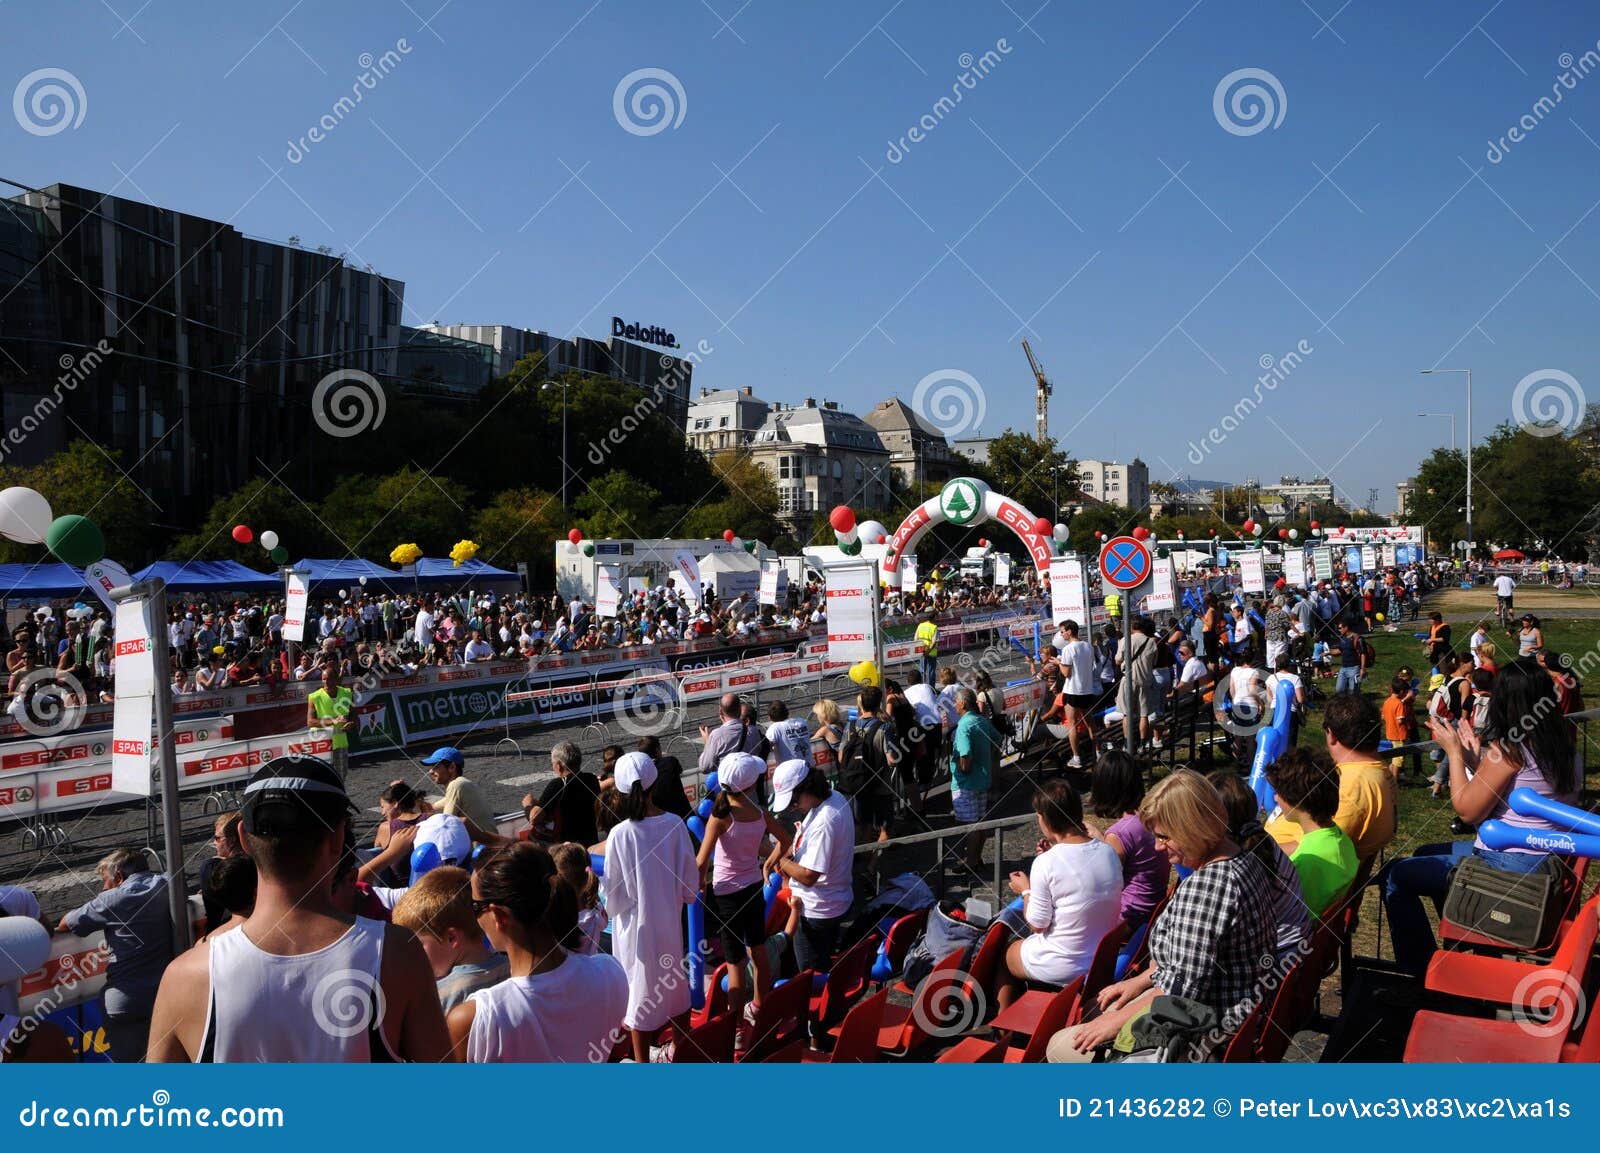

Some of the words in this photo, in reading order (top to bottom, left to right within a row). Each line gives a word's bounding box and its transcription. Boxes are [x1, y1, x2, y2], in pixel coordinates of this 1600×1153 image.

[885, 514, 922, 566] SPAR
[1003, 509, 1047, 562] SPAR
[1147, 593, 1172, 601] TIMEX
[120, 641, 145, 654] SPAR
[446, 669, 477, 681] SPAR
[776, 667, 800, 678] SPAR
[690, 680, 716, 691] SPAR
[177, 698, 224, 711] SPAR
[118, 742, 143, 753] SPAR
[303, 741, 332, 754] SP
[20, 746, 87, 766] SPAR
[201, 751, 259, 772] SPAR
[75, 776, 111, 792] SP
[1526, 834, 1576, 853] SuperShop
